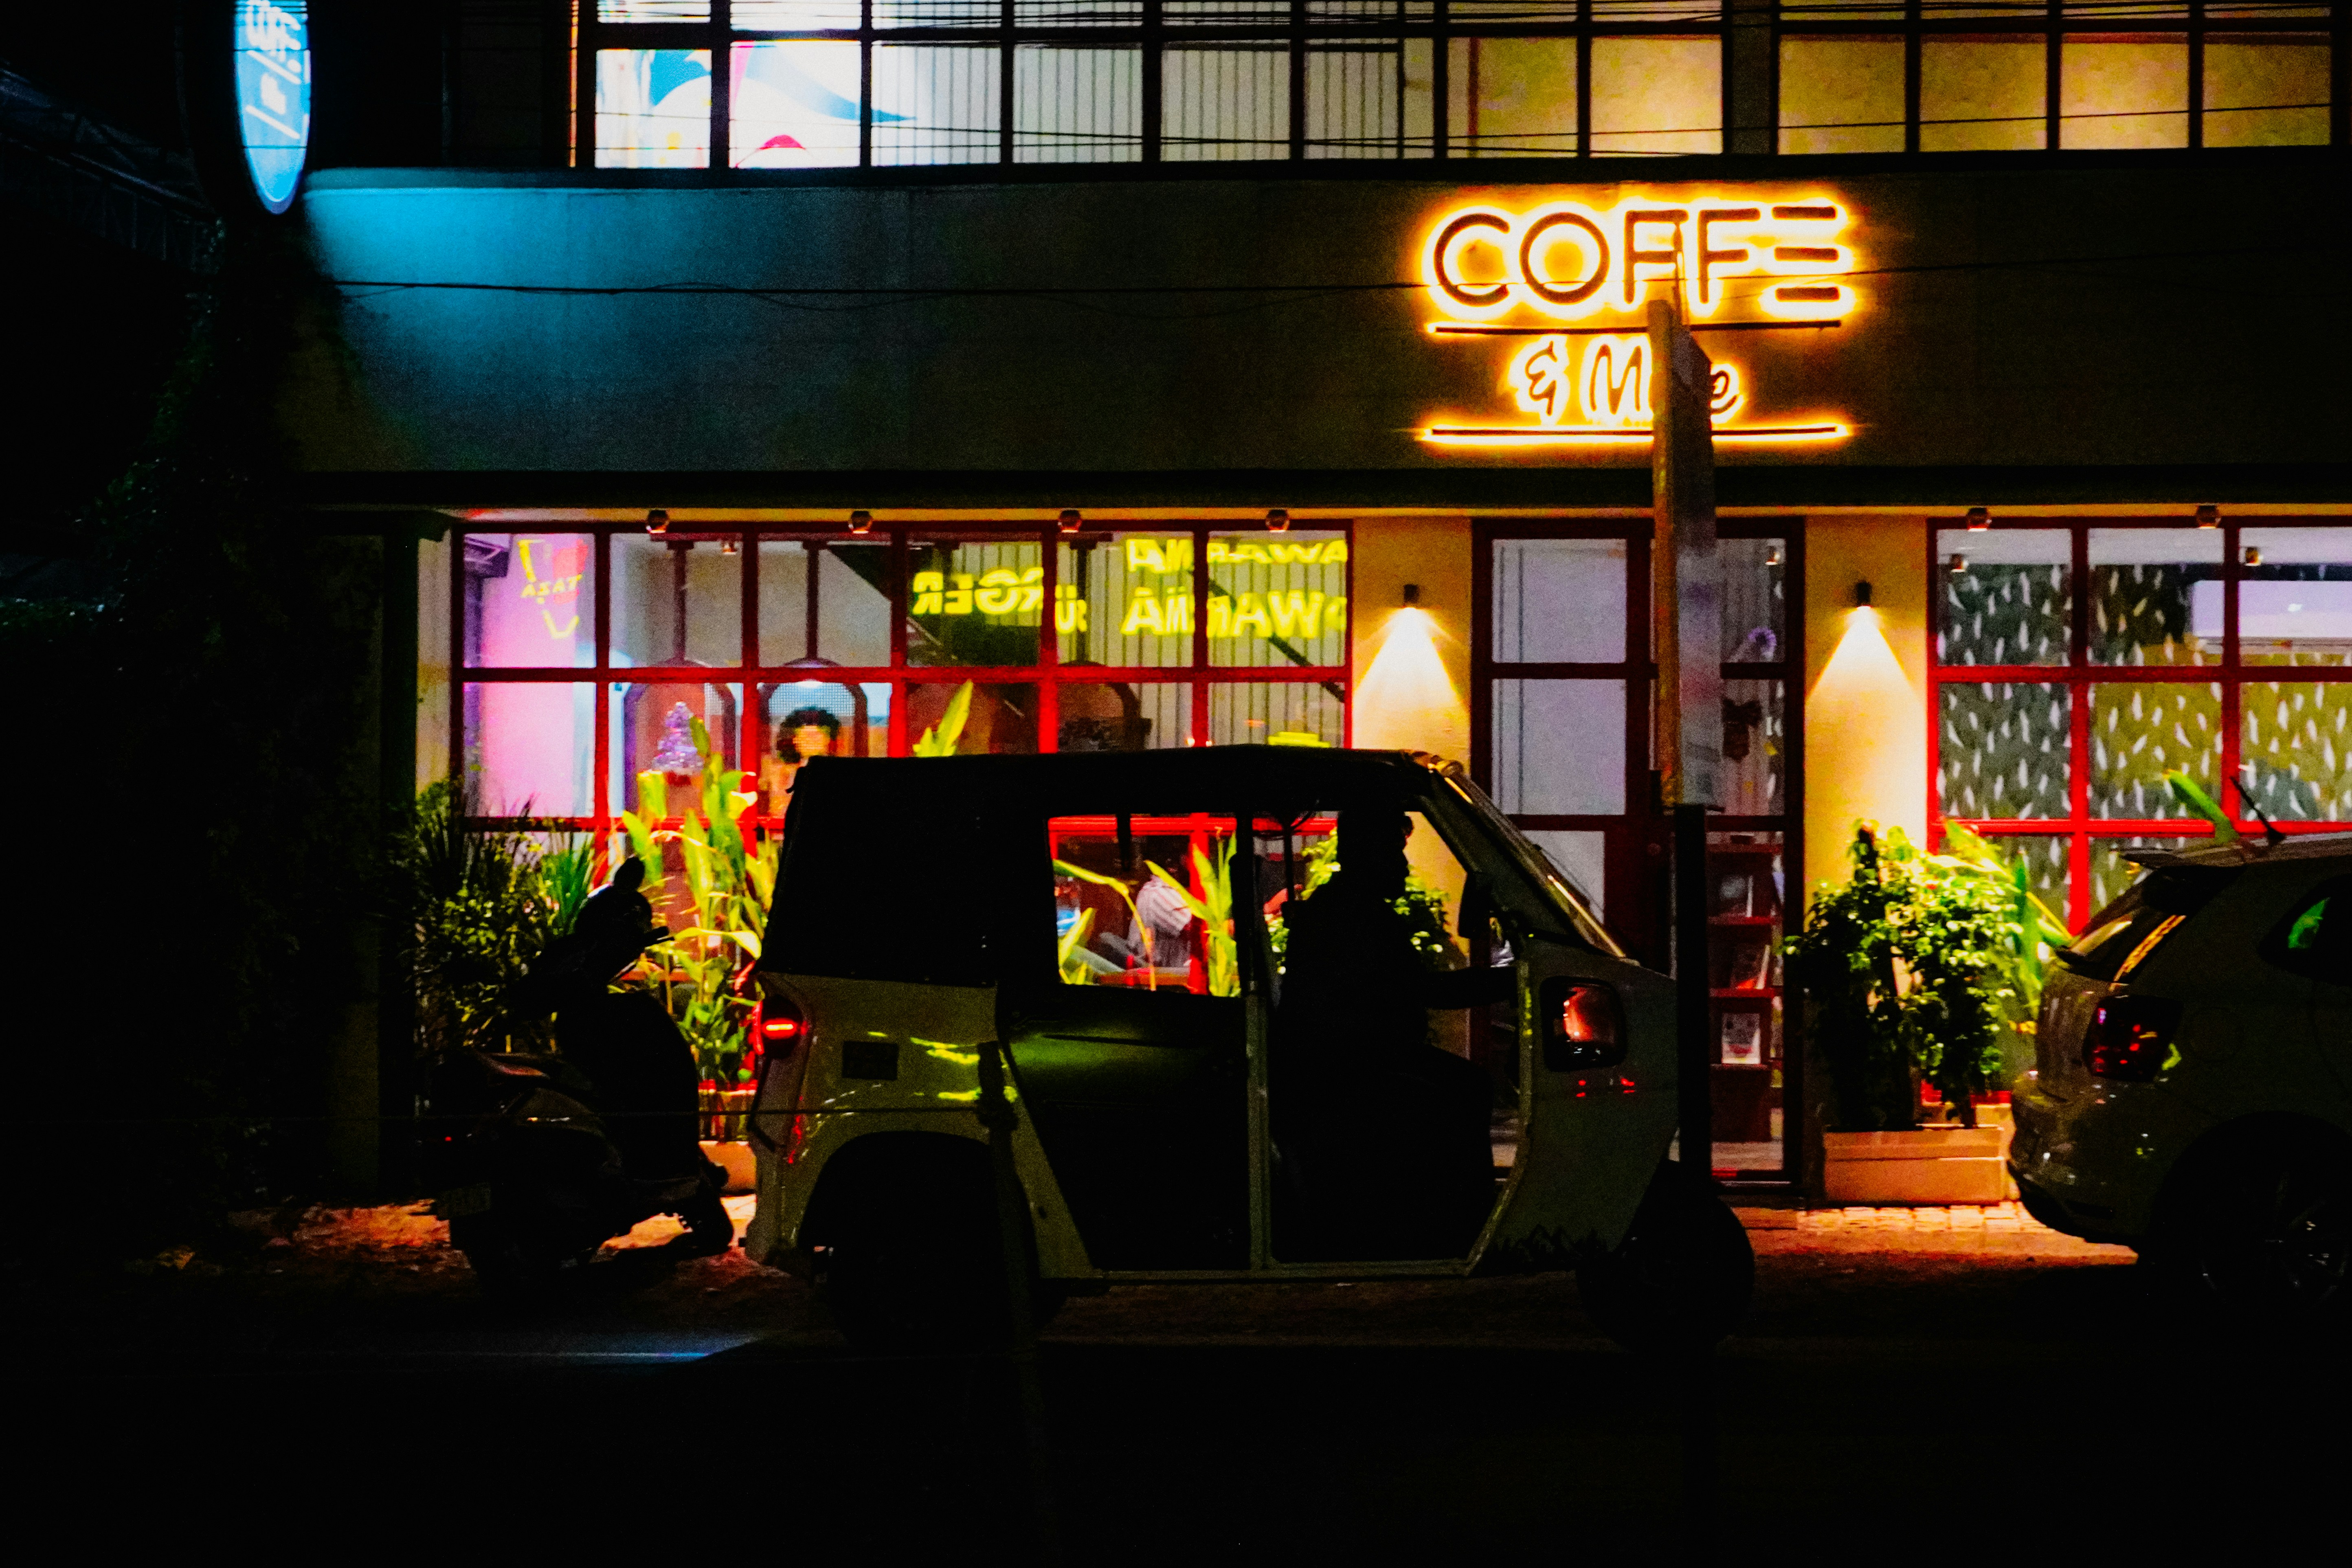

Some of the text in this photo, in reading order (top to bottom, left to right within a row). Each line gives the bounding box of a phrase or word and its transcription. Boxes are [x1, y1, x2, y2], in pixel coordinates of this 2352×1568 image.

[1432, 204, 1843, 307] COFFE
[1523, 339, 1739, 417] & Me
